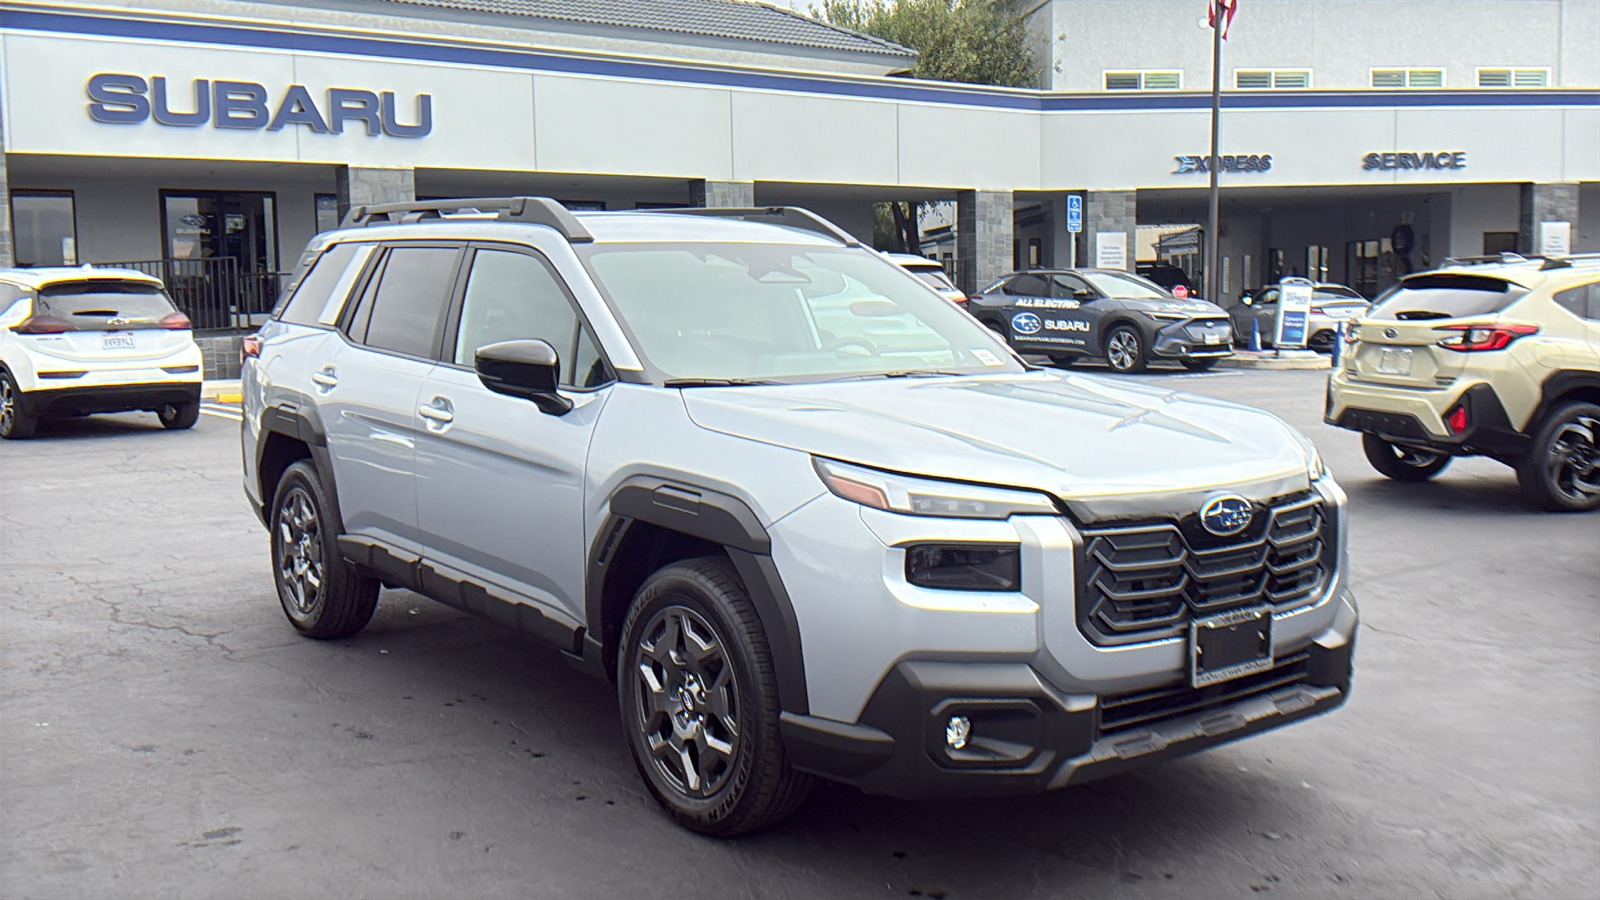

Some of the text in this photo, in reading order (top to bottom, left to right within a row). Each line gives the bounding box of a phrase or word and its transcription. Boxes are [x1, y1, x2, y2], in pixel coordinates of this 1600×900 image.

[86, 73, 432, 138] SUBARU
[1361, 151, 1467, 171] SERVICE
[1015, 298, 1081, 309] ALL ELECTRIC
[1044, 319, 1090, 332] SUBARU
